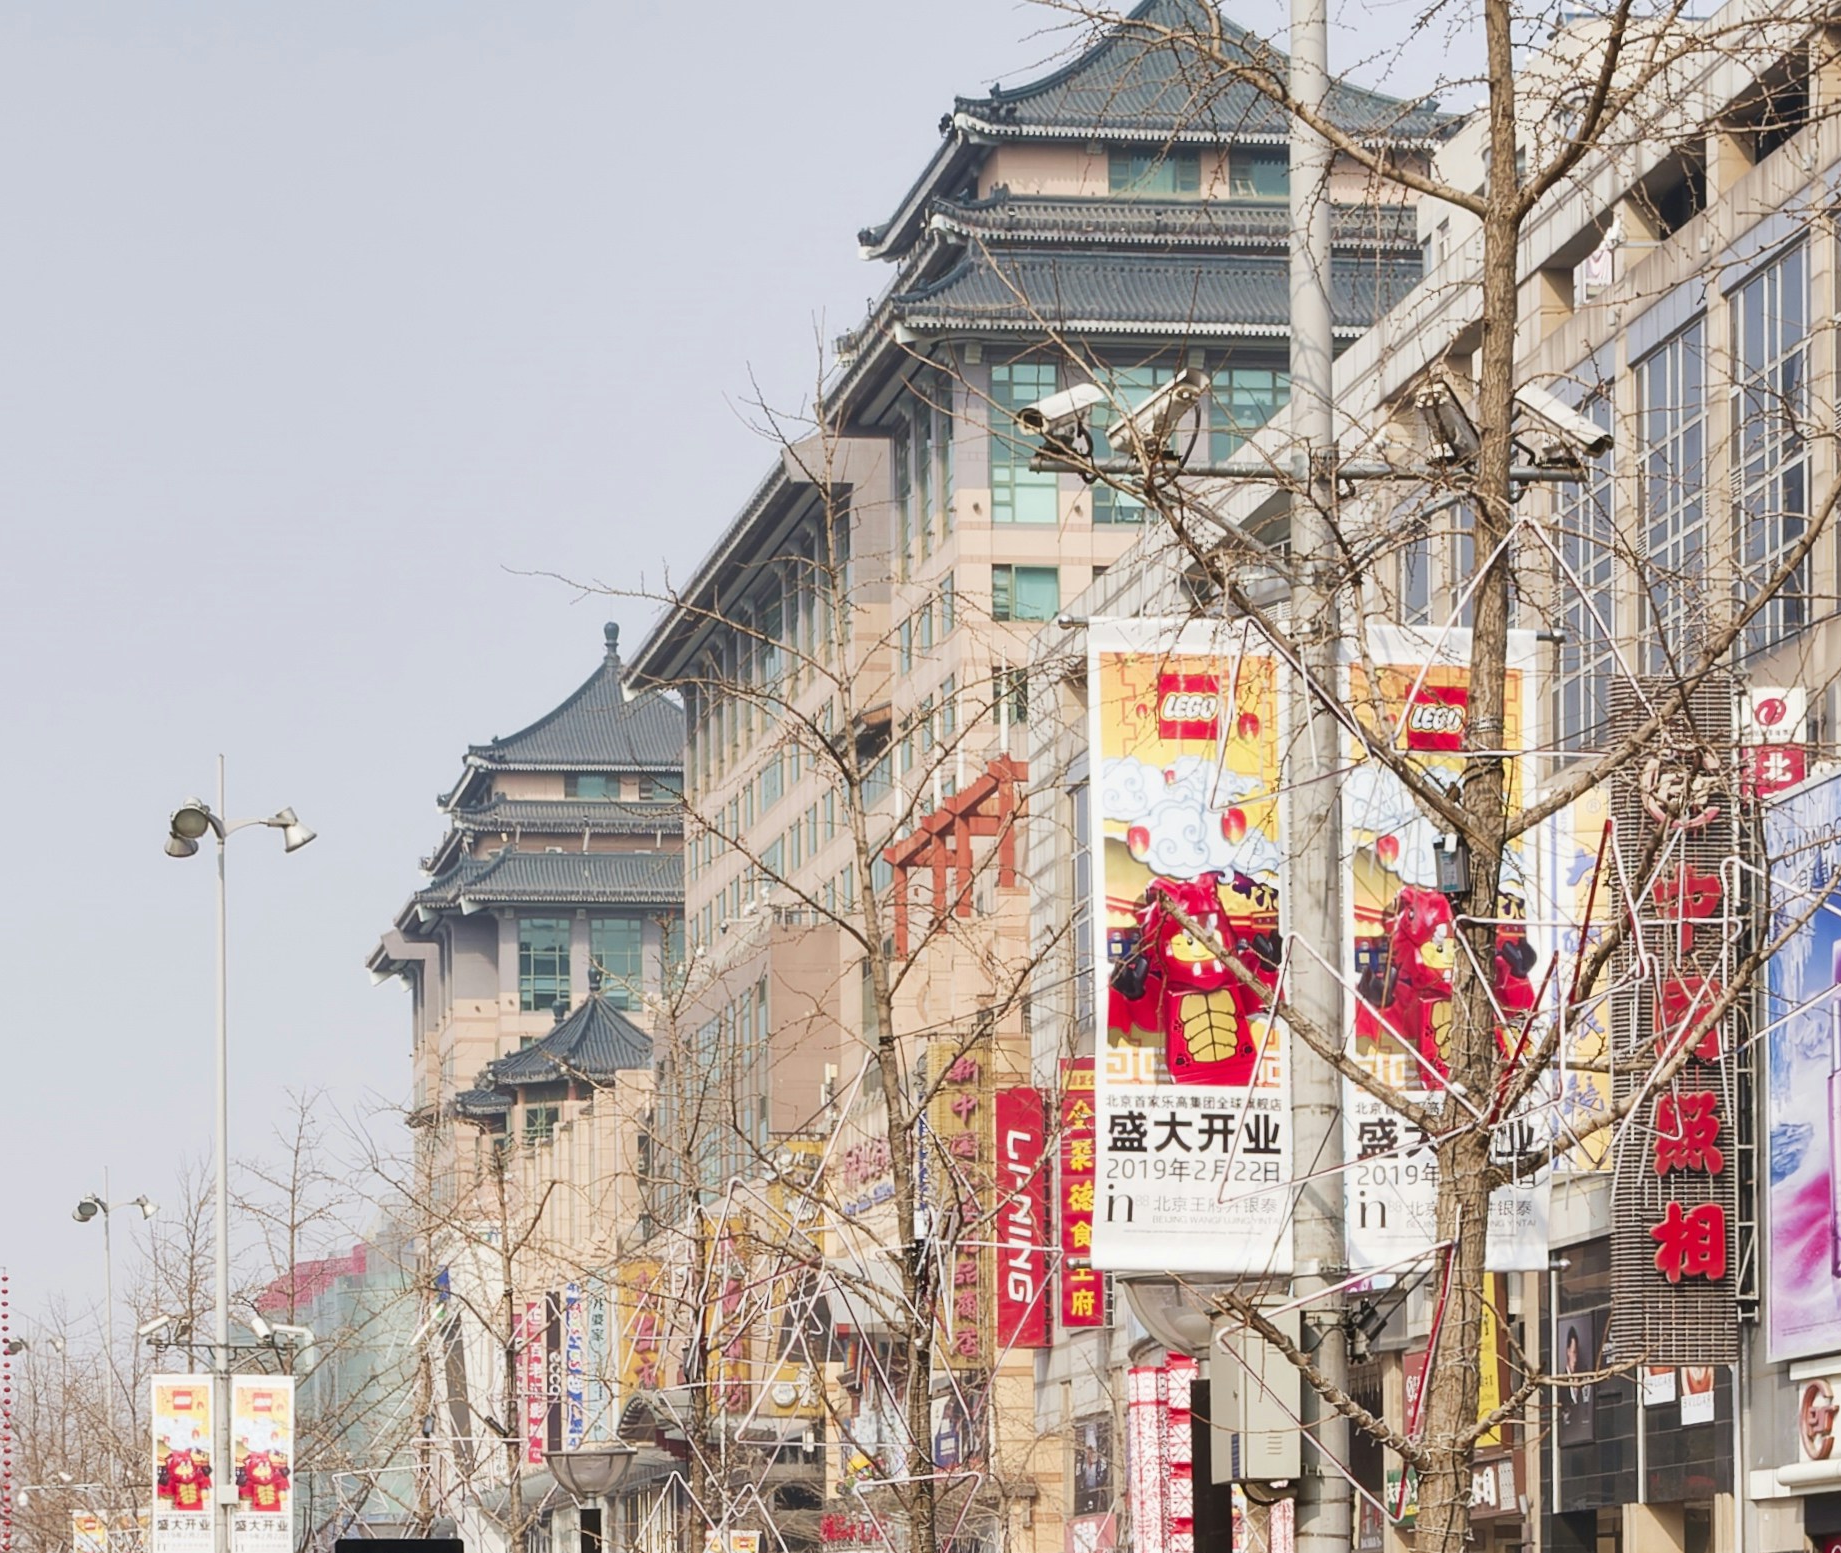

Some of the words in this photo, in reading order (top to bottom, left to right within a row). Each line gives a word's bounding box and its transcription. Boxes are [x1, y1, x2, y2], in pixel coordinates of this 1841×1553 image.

[1162, 692, 1219, 722] LEGO
[1410, 703, 1466, 735] LEGO
[1108, 1111, 1282, 1154] 盛大开业
[1107, 1158, 1281, 1183] 2019年2月22日
[548, 1351, 561, 1395] ecco
[158, 1519, 211, 1531] 盛大开业
[235, 1520, 288, 1532] 盛大开业
